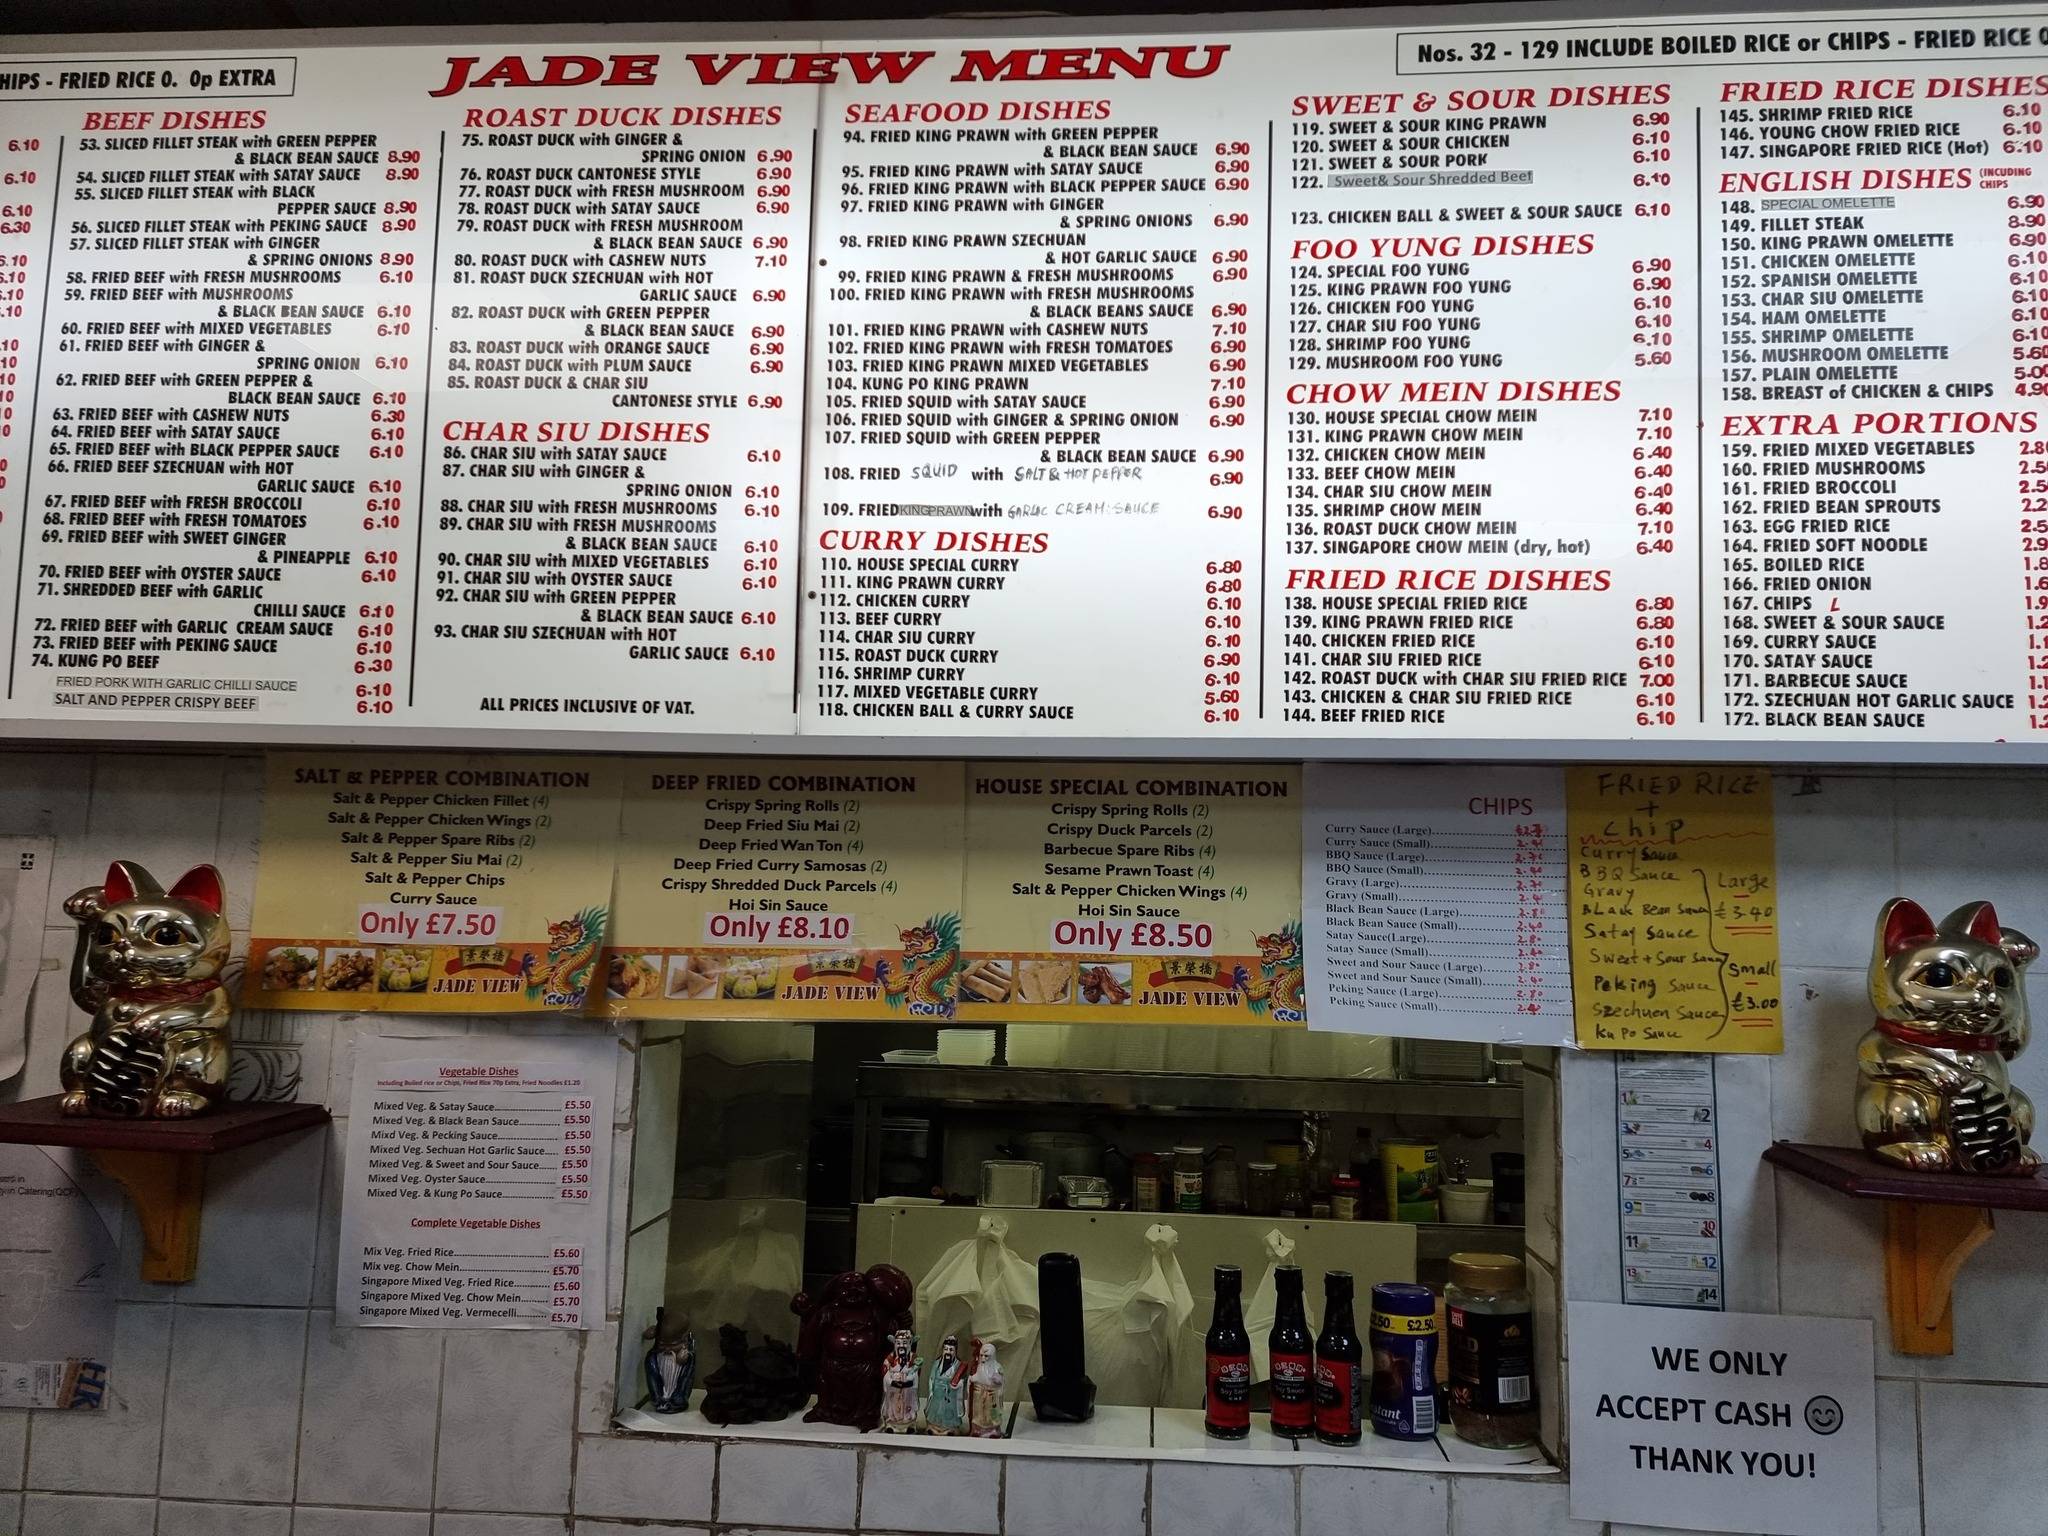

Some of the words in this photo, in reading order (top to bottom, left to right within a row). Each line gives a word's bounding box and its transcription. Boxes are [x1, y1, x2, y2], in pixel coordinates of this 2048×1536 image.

[1419, 45, 1463, 62] Nos.
[1471, 42, 1496, 61] 32
[1522, 40, 1558, 59] 129
[1567, 38, 1653, 58] INCLUDE
[1662, 35, 1736, 55] BOILED
[1745, 34, 1790, 52] RICE
[1798, 38, 1820, 51] or
[1828, 31, 1890, 51] CHIPS
[1915, 29, 1975, 48] FRIED
[1984, 28, 2030, 47] RICE
[59, 72, 110, 89] FRIED
[116, 71, 155, 88] RICE
[219, 69, 276, 86] EXTRA
[428, 55, 660, 97] JADE
[685, 51, 936, 85] VIEW
[950, 45, 1231, 82] MENU
[1720, 81, 1823, 102] FRIED
[1833, 79, 1915, 99] RICE
[1925, 75, 2048, 98] DISHES
[1292, 94, 1403, 116] SWEET
[1413, 92, 1436, 112] &
[1448, 89, 1536, 111] SOUR
[1548, 84, 1670, 107] DISHES
[82, 112, 154, 130] BEEF
[160, 110, 266, 130] DISHES
[463, 108, 568, 127] ROAST
[575, 108, 662, 126] DUCK
[670, 106, 781, 126] DISHES
[845, 103, 988, 123] SEAFOOD
[998, 100, 1110, 120] DISHES
[101, 171, 145, 183] SLICED
[149, 170, 190, 182] FILLET
[194, 169, 235, 183] STEAK
[239, 168, 269, 181] with
[274, 169, 314, 181] SATAY
[319, 168, 360, 181] SAUCE
[386, 168, 419, 181] 8.90
[487, 168, 531, 180] ROAST
[536, 168, 572, 180] DUCK
[578, 167, 656, 180] CANTONESE
[661, 167, 701, 180] STYLE
[757, 167, 791, 180] 6.90
[1719, 171, 1852, 193] ENGLISH
[1861, 168, 1971, 189] DISHES
[1979, 168, 2032, 178] (INCUDING
[1980, 180, 2008, 189] CHIPS
[1722, 200, 1755, 215] 148.
[1761, 199, 1819, 211] SPECIAL
[1821, 197, 1896, 210] OMELETTE
[2008, 195, 2045, 209] 6.90
[1291, 239, 1357, 259] FOO
[1371, 237, 1461, 257] YUNG
[1472, 234, 1594, 255] DISHES
[1287, 383, 1390, 404] CHOW
[1400, 382, 1488, 402] MEIN
[1498, 381, 1621, 401] DISHES
[443, 421, 528, 442] CHAR
[537, 422, 590, 442] SIU
[598, 422, 710, 443] DISHES
[1721, 414, 1840, 436] EXTRA
[1852, 412, 2037, 434] PORTIONS
[820, 530, 925, 550] CURRY
[934, 532, 1048, 553] DISHES
[1285, 570, 1385, 589] FRIED
[1395, 570, 1476, 590] RICE
[1486, 570, 1610, 591] DISHES
[856, 594, 916, 607] CHICKEN
[922, 595, 970, 608] CURRY
[1207, 596, 1241, 609] 6.10
[55, 693, 85, 704] SALT
[88, 695, 117, 705] AND
[122, 695, 170, 707] PEPPER
[175, 697, 220, 708] CRISPY
[224, 698, 256, 709] BEEF
[357, 702, 393, 713] 6.10
[480, 698, 504, 711] ALL
[510, 698, 558, 712] PRICES
[564, 699, 637, 713] INCLUSIVE
[642, 701, 660, 713] OF
[665, 701, 694, 714] VAT.
[295, 768, 341, 784] SALT
[347, 771, 363, 784] &
[370, 769, 439, 785] PEPPER
[445, 770, 589, 787] COMBINATION
[652, 775, 699, 790] DEEP
[707, 775, 761, 791] FRIED
[768, 776, 915, 792] COMBINATION
[1598, 773, 1681, 796] FRIED
[1696, 772, 1760, 795] RICE
[976, 779, 1042, 794] HOUSE
[1050, 779, 1128, 795] SPECIAL
[1136, 780, 1287, 797] COMBINATION
[1052, 803, 1096, 818] Crispy
[1102, 804, 1149, 819] Spring
[1153, 804, 1188, 816] Rolls
[1193, 804, 1209, 820] (2)
[1469, 797, 1533, 815] CHIPS
[365, 872, 393, 883] Salt
[397, 872, 407, 884] &
[412, 873, 462, 888] Pepper
[466, 874, 505, 888] Chips
[1718, 872, 1769, 893] Large
[1326, 904, 1354, 913] Black
[1358, 904, 1383, 914] Bean
[1387, 906, 1415, 915] Sauce
[361, 912, 419, 939] Only
[426, 914, 496, 935] £7.50
[710, 915, 770, 943] Only
[778, 917, 849, 939] £8.10
[1055, 921, 1122, 950] Only
[1131, 923, 1212, 947] £8.50
[1139, 991, 1187, 1006] JADE
[1193, 992, 1241, 1006] VIEW
[439, 1067, 487, 1078] Vegetable
[488, 1067, 520, 1077] Dishes
[373, 1116, 403, 1125] Mixed
[405, 1117, 425, 1126] Veg.
[428, 1116, 436, 1125] &
[439, 1116, 463, 1125] Black
[466, 1117, 489, 1125] Bean
[564, 1114, 590, 1123] £5.50
[1701, 1108, 1711, 1122] 2
[1704, 1139, 1712, 1149] 4
[1624, 1201, 1633, 1213] 9
[411, 1218, 457, 1228] Complete
[460, 1219, 507, 1229] Vegetable
[510, 1219, 540, 1229] Dishes
[1626, 1235, 1638, 1247] 11
[1702, 1256, 1717, 1269] 12
[1703, 1288, 1718, 1300] 14
[360, 1305, 408, 1318] Singapore
[409, 1307, 440, 1317] Mixed
[442, 1307, 464, 1319] Veg.
[551, 1312, 577, 1323] £5.70
[1651, 1346, 1699, 1372] WE
[1709, 1350, 1787, 1376] ONLY
[1596, 1394, 1706, 1422] ACCEPT
[1715, 1401, 1791, 1427] CASH
[1630, 1445, 1734, 1474] THANK
[1741, 1451, 1815, 1478] YOU!
